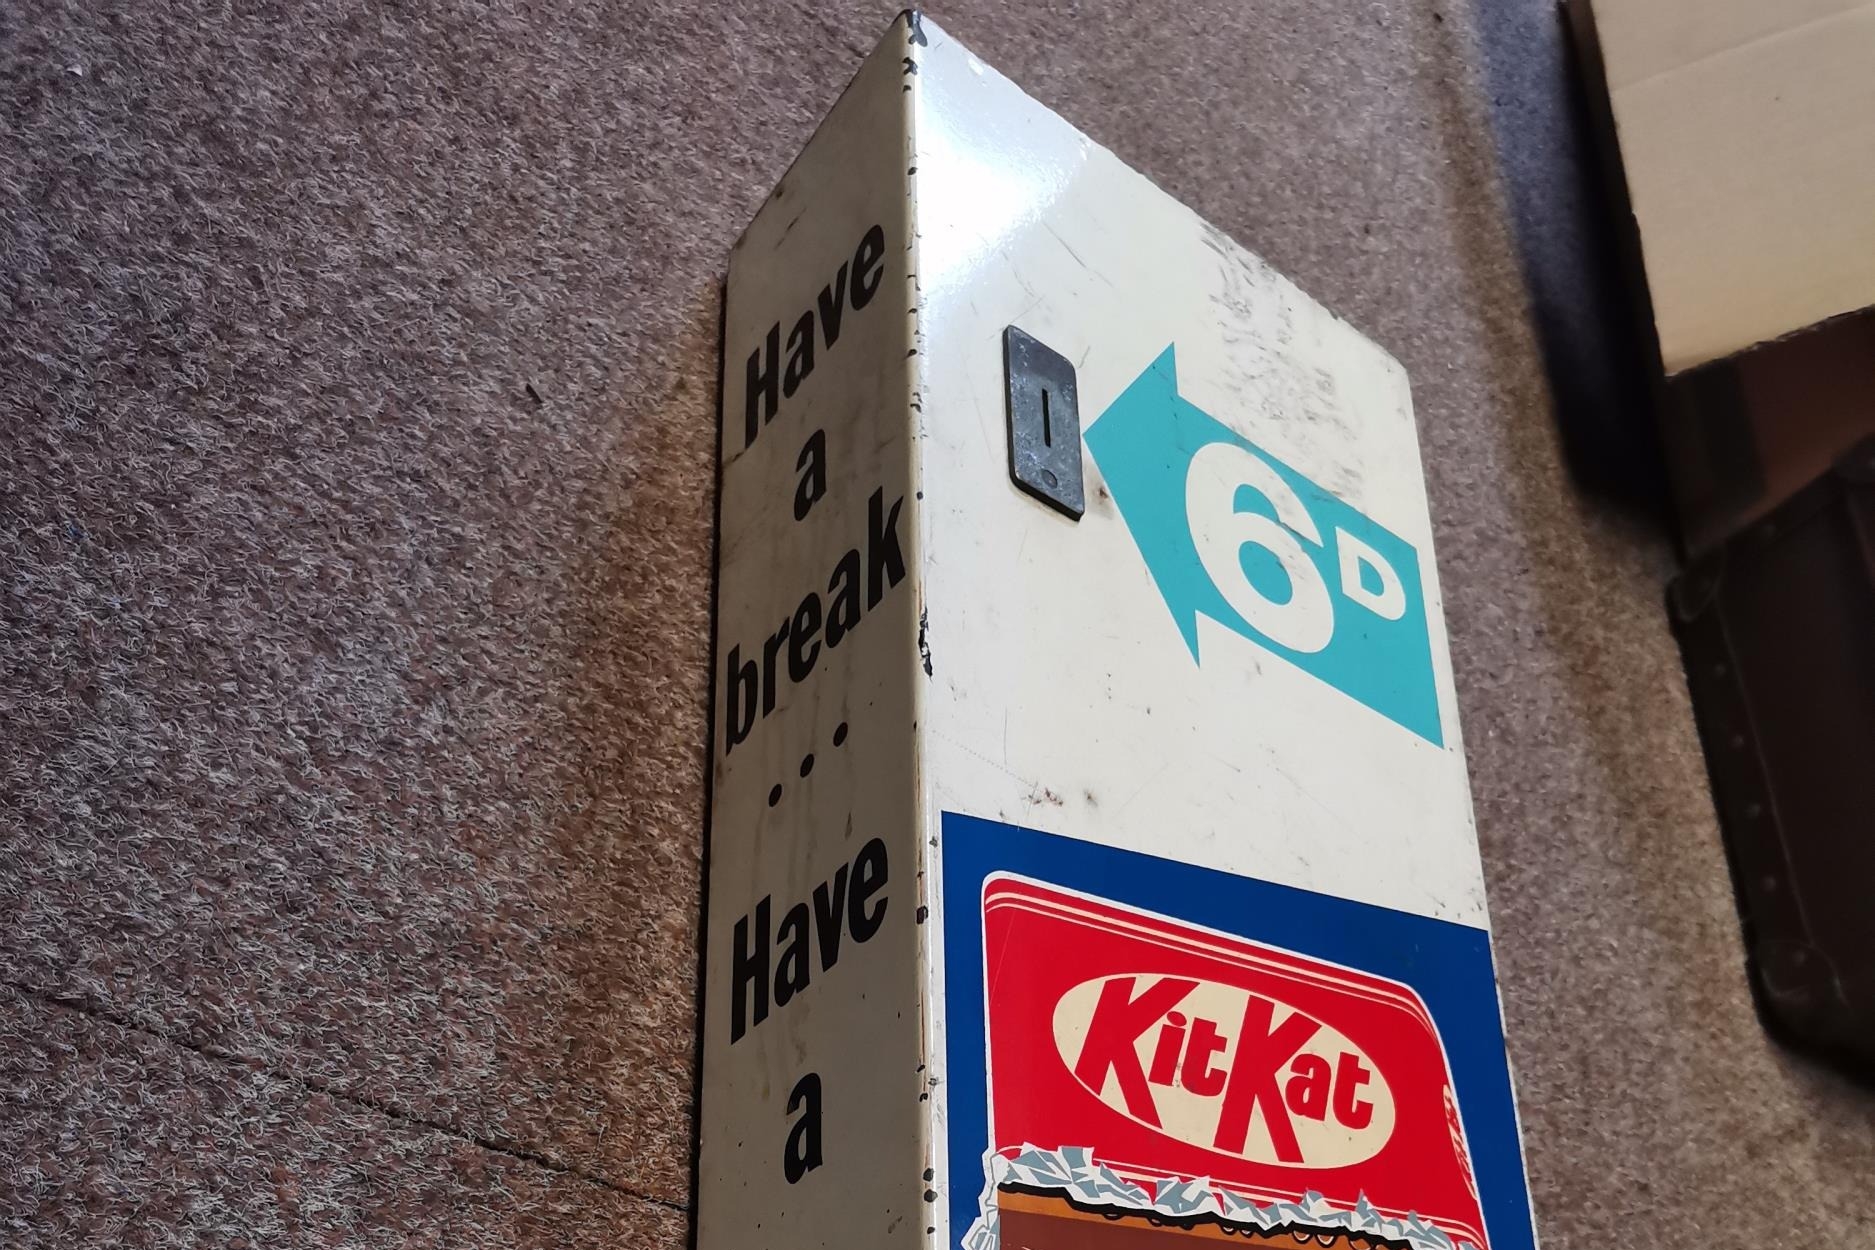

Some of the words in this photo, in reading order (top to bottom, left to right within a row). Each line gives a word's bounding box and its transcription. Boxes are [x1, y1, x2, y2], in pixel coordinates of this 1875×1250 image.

[745, 224, 886, 450] Have
[793, 428, 827, 522] a
[725, 485, 907, 757] break
[730, 837, 889, 1046] Have
[784, 1071, 822, 1186] a
